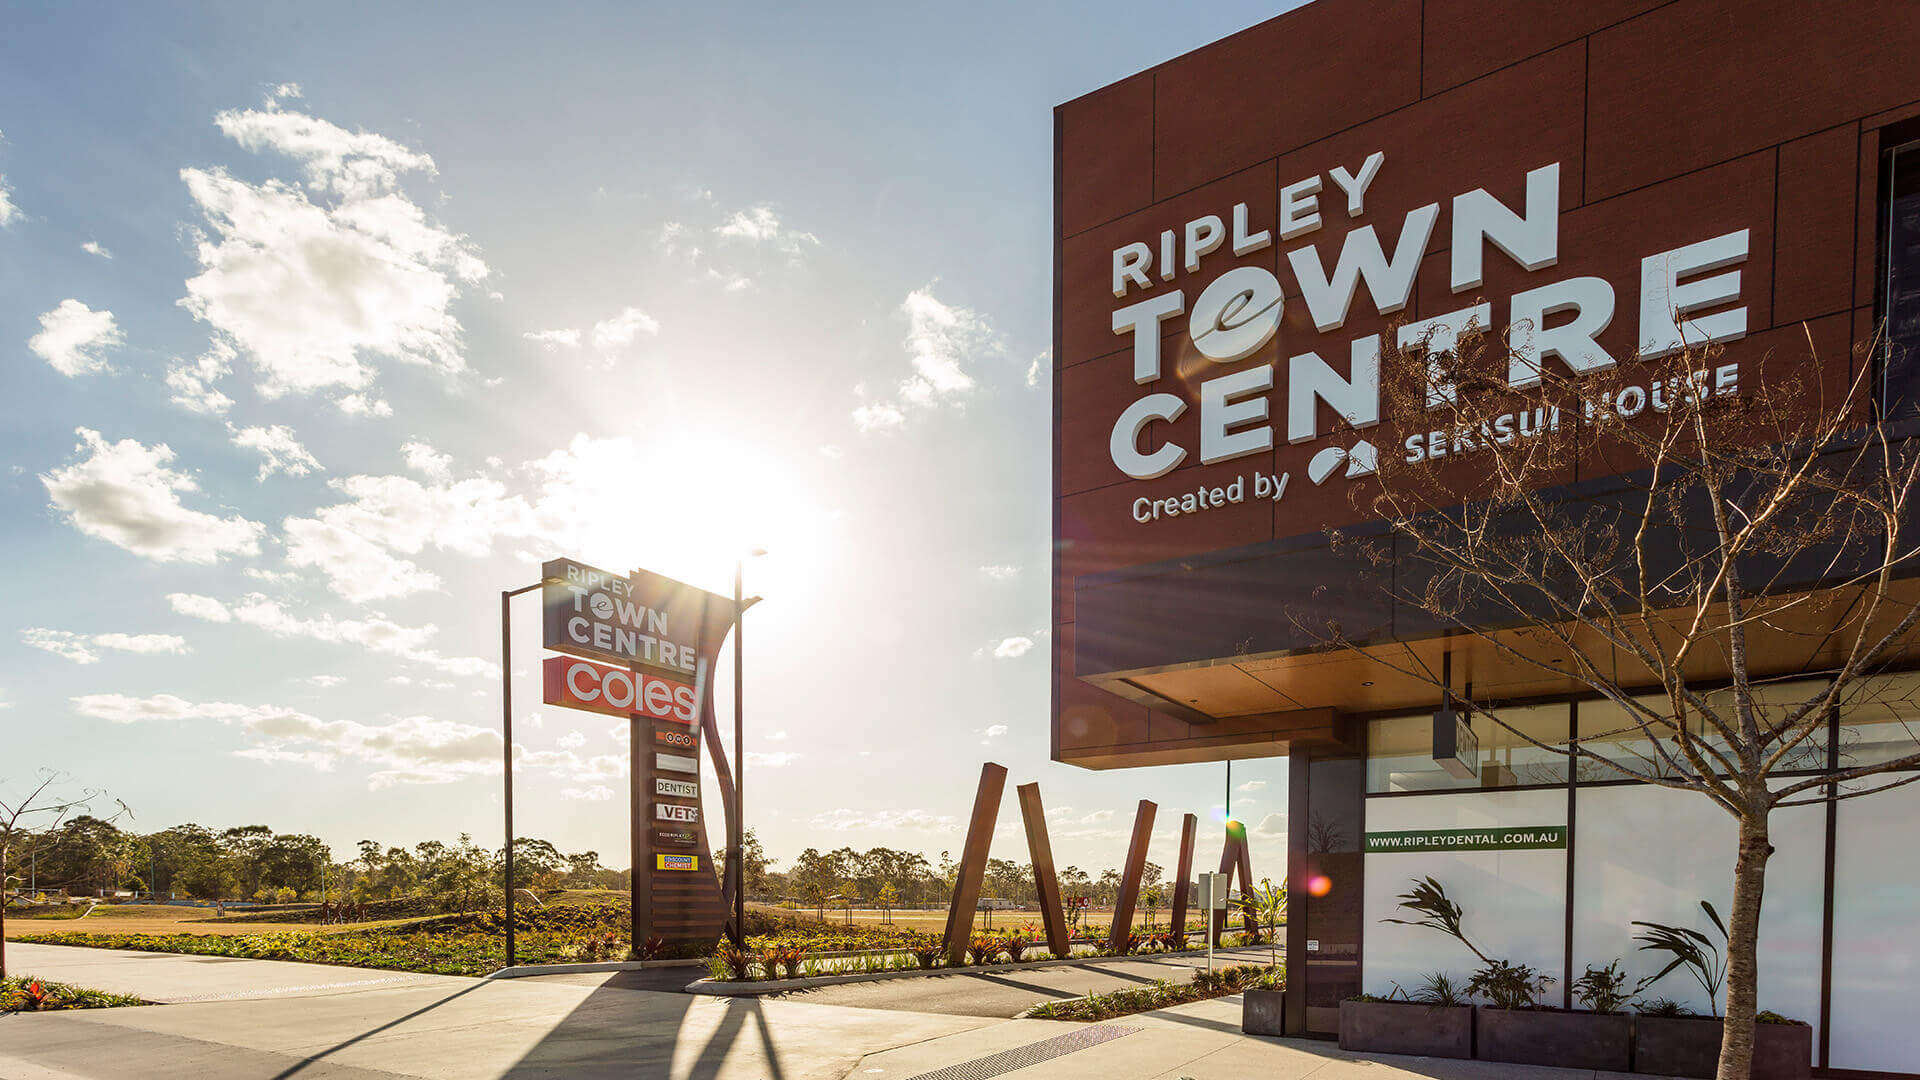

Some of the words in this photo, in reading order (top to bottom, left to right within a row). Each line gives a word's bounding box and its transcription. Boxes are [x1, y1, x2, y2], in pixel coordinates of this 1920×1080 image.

[1112, 150, 1384, 297] RIPLEY
[1110, 228, 1749, 480] CENTRE
[1132, 477, 1245, 524] Created
[1253, 471, 1291, 508] by
[567, 564, 634, 597] RIPLEY
[567, 616, 696, 672] CENTRE
[657, 782, 697, 795] DENTIST
